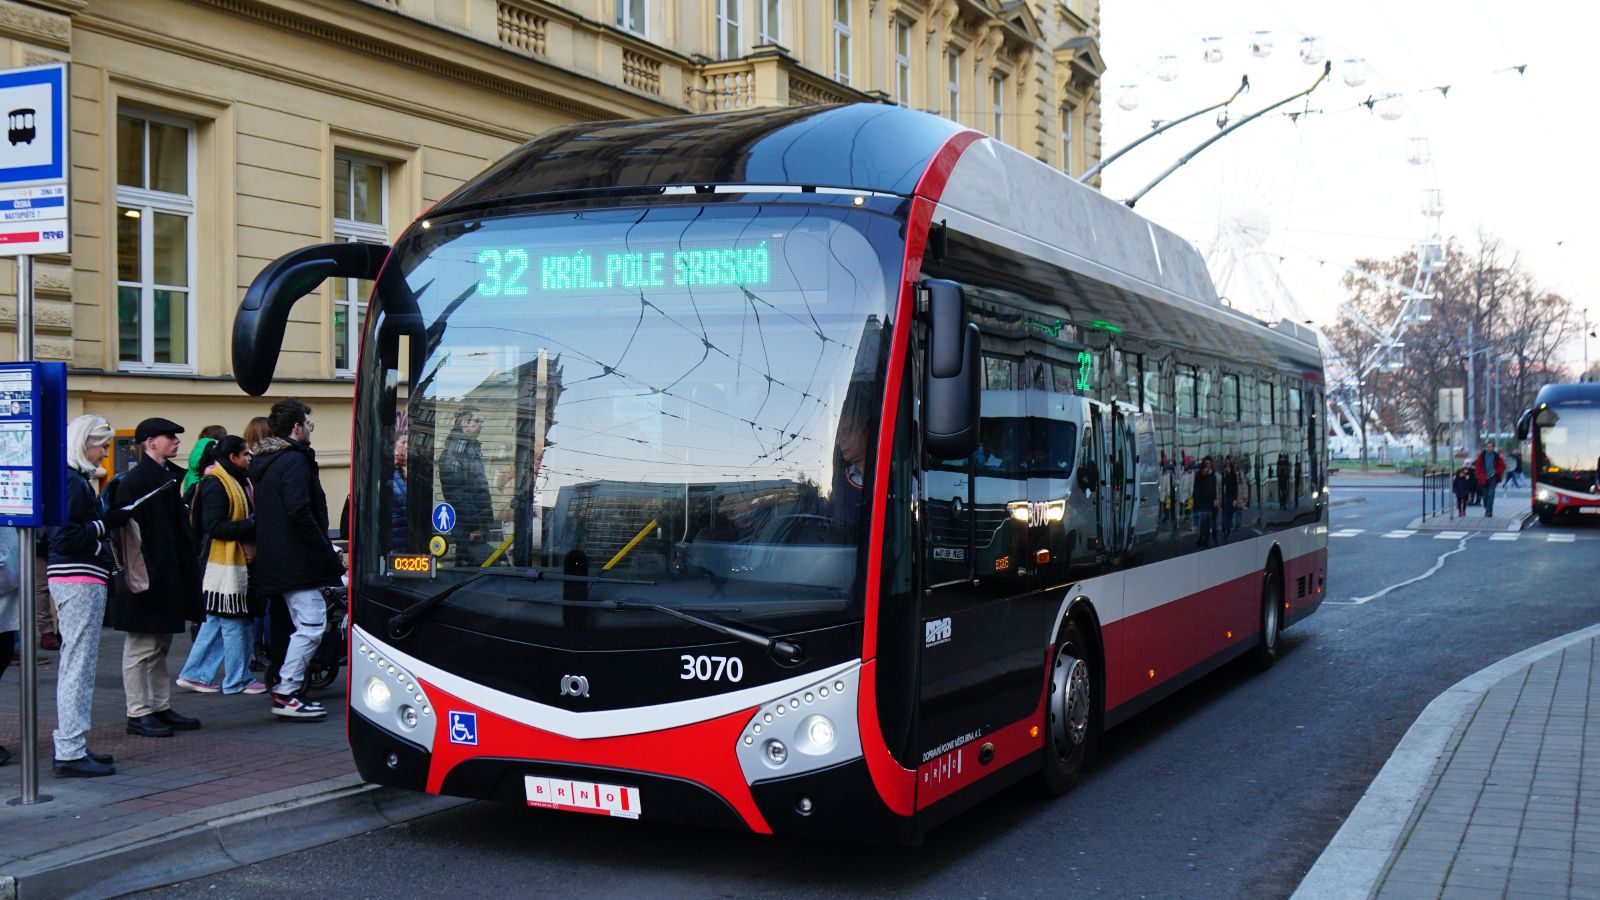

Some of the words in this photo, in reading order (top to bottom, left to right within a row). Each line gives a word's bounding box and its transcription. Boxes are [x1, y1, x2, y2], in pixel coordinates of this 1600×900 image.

[477, 248, 529, 296] 32
[673, 240, 770, 285] SRBSKÁ
[1076, 352, 1091, 391] 32
[1028, 501, 1049, 528] 3070
[394, 557, 429, 571] 03205
[680, 654, 744, 683] 3070
